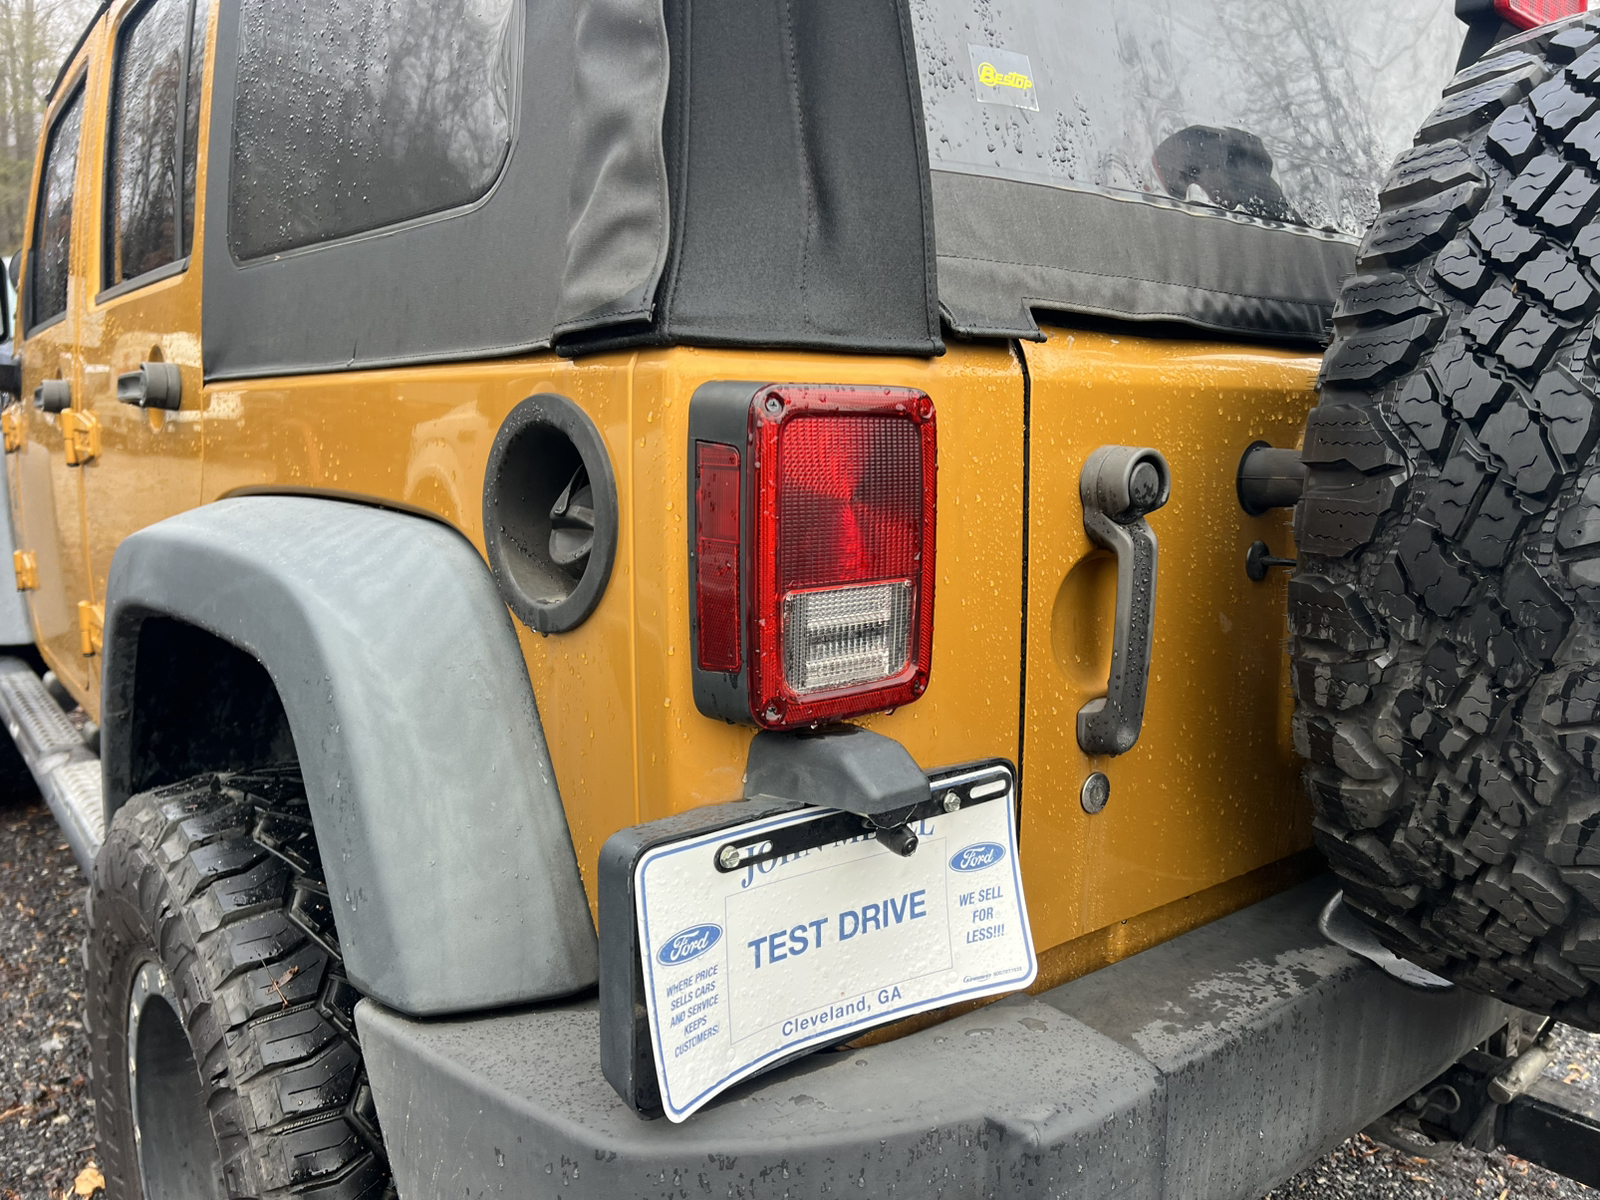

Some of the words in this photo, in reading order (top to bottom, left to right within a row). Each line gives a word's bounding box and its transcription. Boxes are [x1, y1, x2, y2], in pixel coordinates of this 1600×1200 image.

[741, 841, 823, 889] JO
[960, 846, 995, 869] Ford
[959, 892, 975, 907] WE
[978, 886, 1004, 903] SELL
[747, 917, 829, 970] TEST
[838, 889, 927, 942] DRIVE
[972, 907, 994, 923] FOR
[669, 930, 710, 961] Ford
[966, 924, 1005, 944] LESS!!!
[666, 976, 693, 998] WHERE
[695, 964, 719, 984] PRICE
[670, 991, 693, 1011] SELLS
[695, 980, 716, 999] CARS
[670, 1011, 686, 1029] AND
[687, 994, 719, 1019] SERVICE
[684, 1015, 707, 1037] KEEPS
[782, 996, 872, 1036] Cleveland,
[878, 986, 903, 1005] GA
